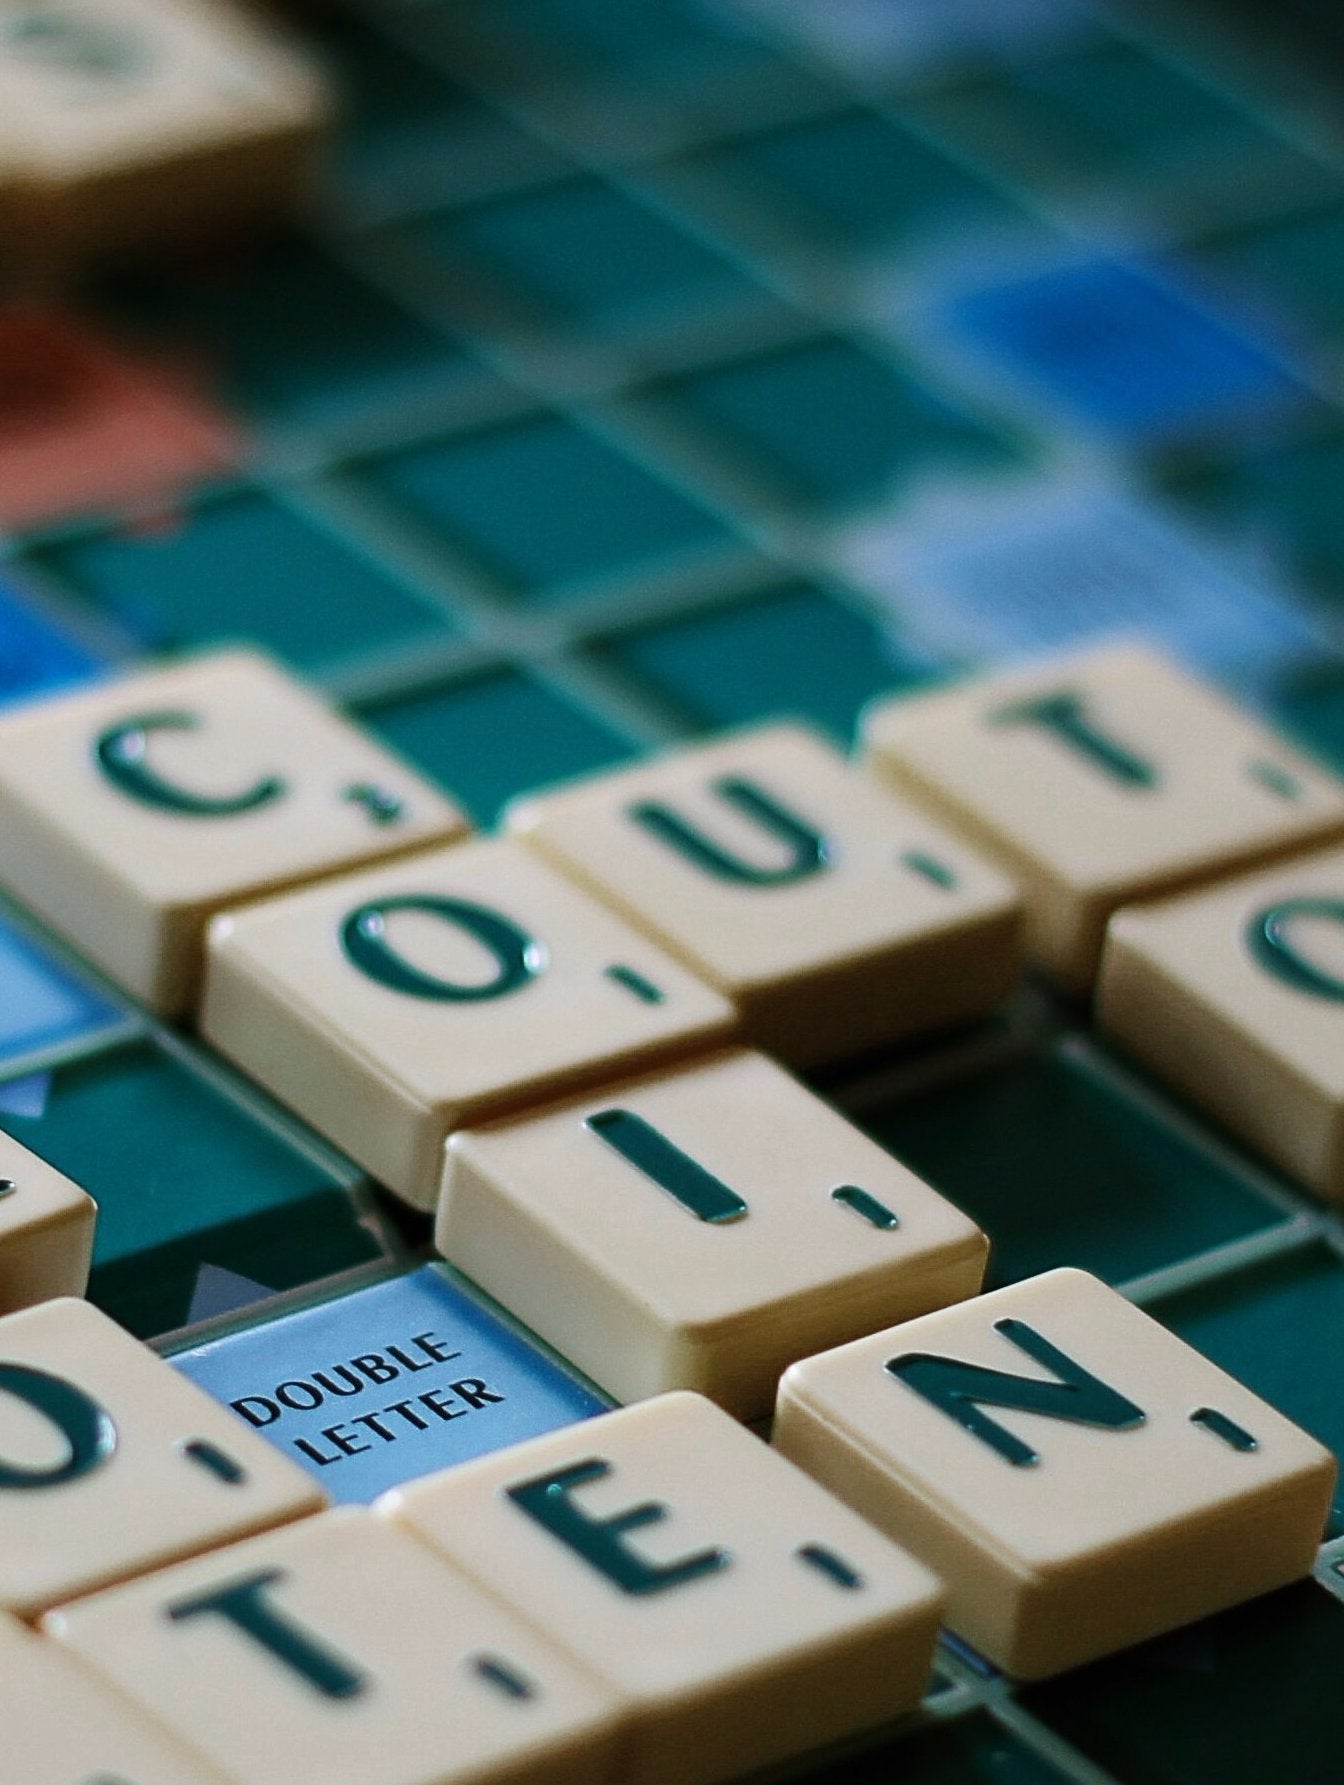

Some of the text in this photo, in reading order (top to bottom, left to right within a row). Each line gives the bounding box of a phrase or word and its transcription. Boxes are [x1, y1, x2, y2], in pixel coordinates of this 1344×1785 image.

[93, 711, 288, 818] C
[991, 689, 1161, 794] T
[628, 777, 958, 891] U 1
[338, 893, 664, 1006] O 1
[584, 1109, 900, 1231] I 1
[230, 1331, 462, 1429] DOUBLE
[293, 1377, 506, 1467] LETTER
[886, 1319, 1260, 1467] N 1
[184, 1440, 245, 1485] 1
[504, 1458, 864, 1595] E 1
[168, 1570, 538, 1703] T 1
